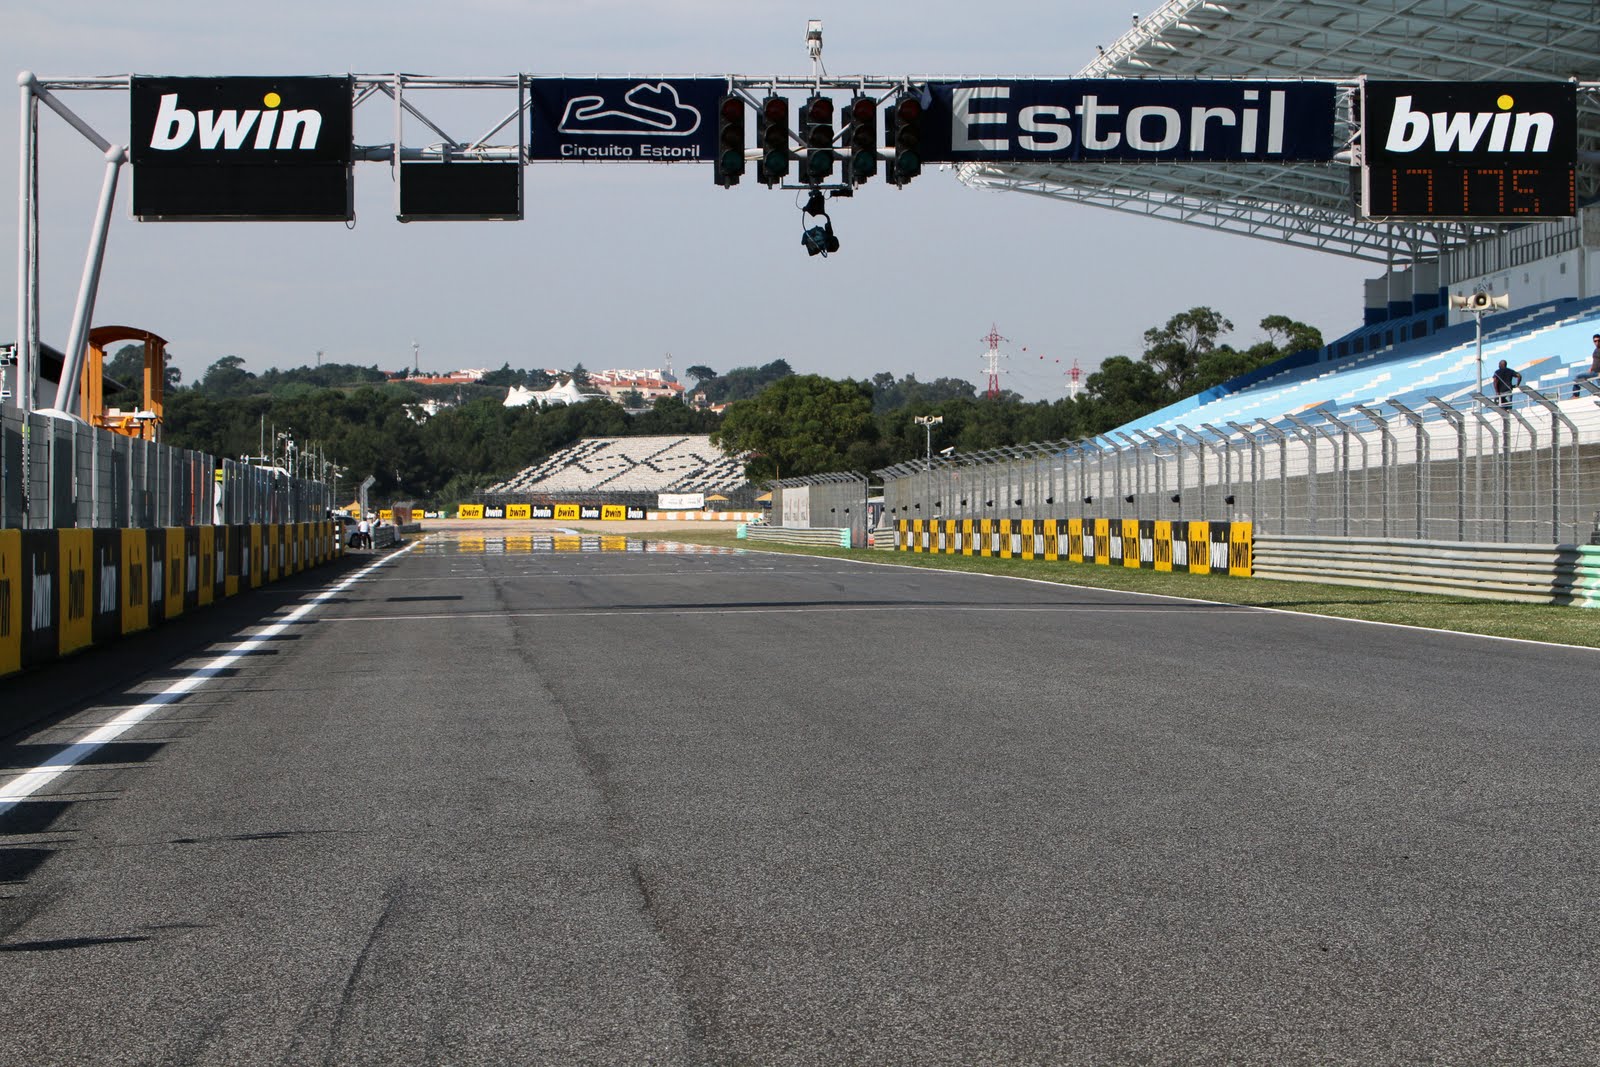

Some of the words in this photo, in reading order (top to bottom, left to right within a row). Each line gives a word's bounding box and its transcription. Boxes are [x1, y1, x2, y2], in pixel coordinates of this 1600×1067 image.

[150, 92, 323, 151] bwin
[951, 86, 1286, 154] Estoril
[1385, 94, 1554, 152] bwin
[560, 143, 633, 157] Circuito
[640, 143, 700, 157] Estoril
[461, 506, 480, 517] bwin
[485, 505, 503, 518] bwin
[509, 506, 527, 517] bwin
[532, 505, 552, 518] bwin
[557, 507, 575, 518] bwin
